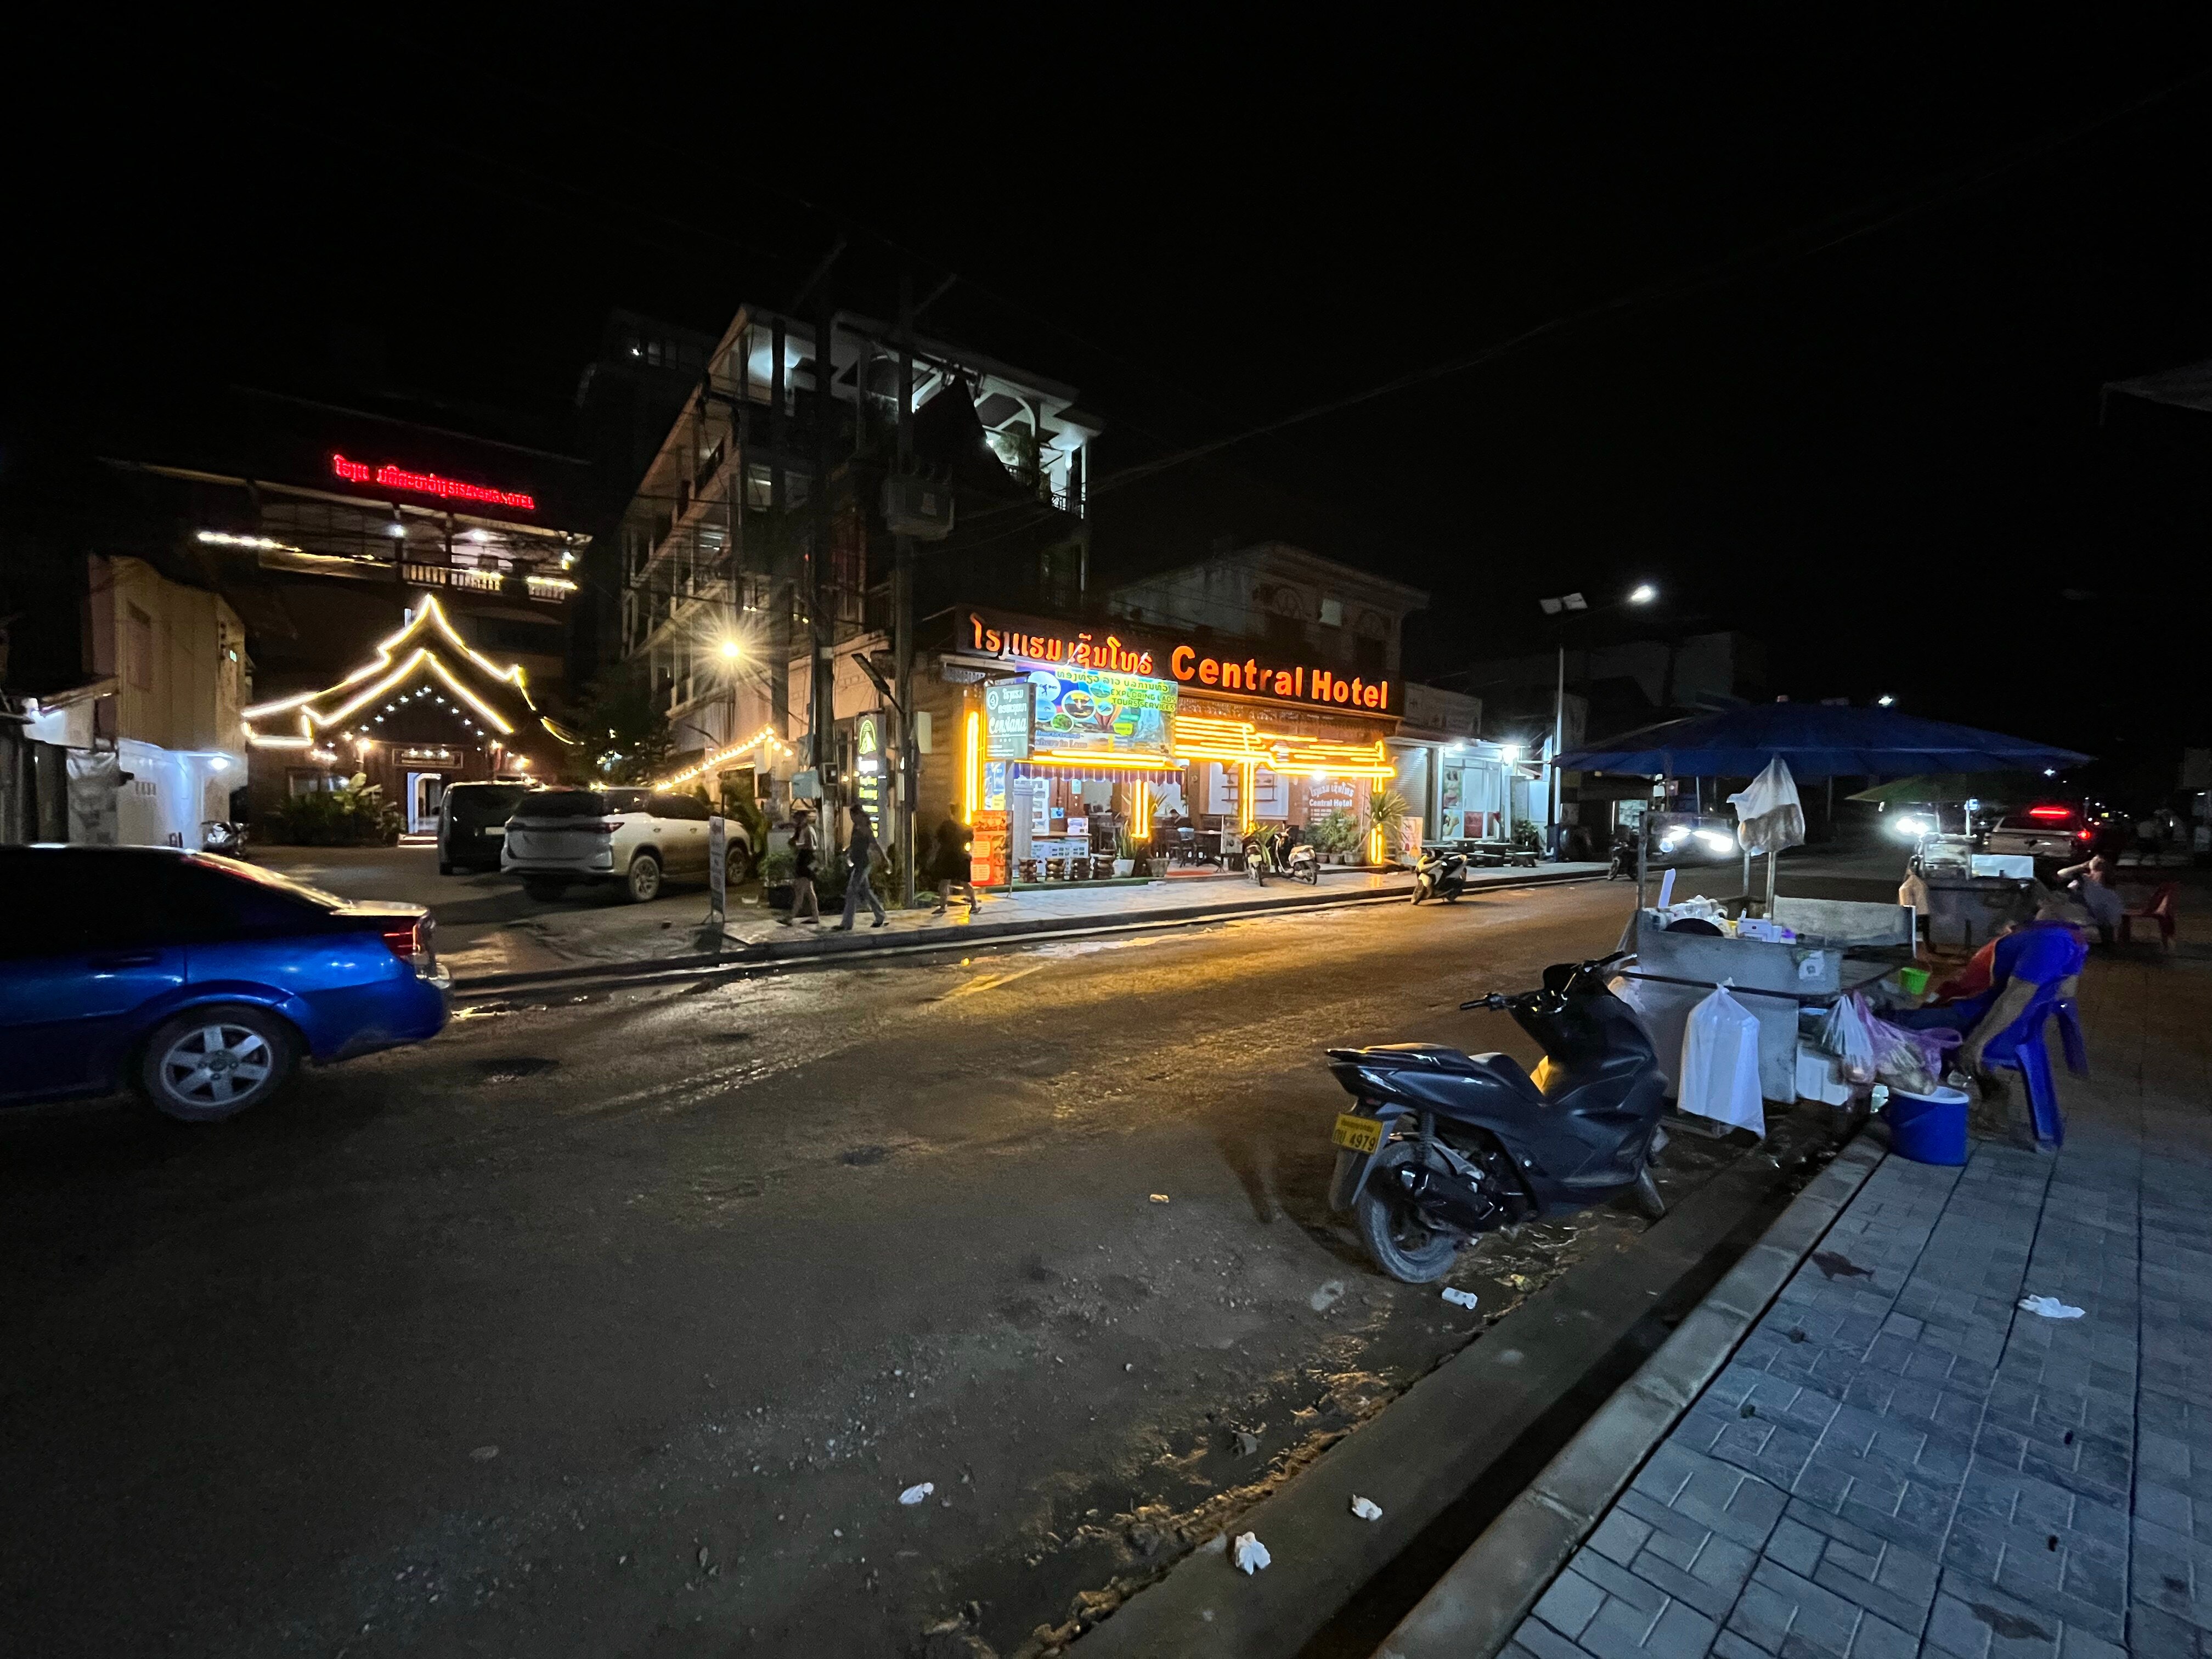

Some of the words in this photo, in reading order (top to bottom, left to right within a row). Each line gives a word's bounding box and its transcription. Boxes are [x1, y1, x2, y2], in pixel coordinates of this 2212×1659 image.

[970, 612, 1062, 661] ໂຮງແຮມ
[1171, 645, 1303, 697] Central
[1312, 669, 1387, 709] Hotel
[1110, 689, 1155, 701] EXPLORING
[1158, 695, 1176, 703] LAOS
[1309, 798, 1333, 807] Central
[1334, 799, 1352, 807] Hotel
[1350, 1133, 1376, 1151] 4979
